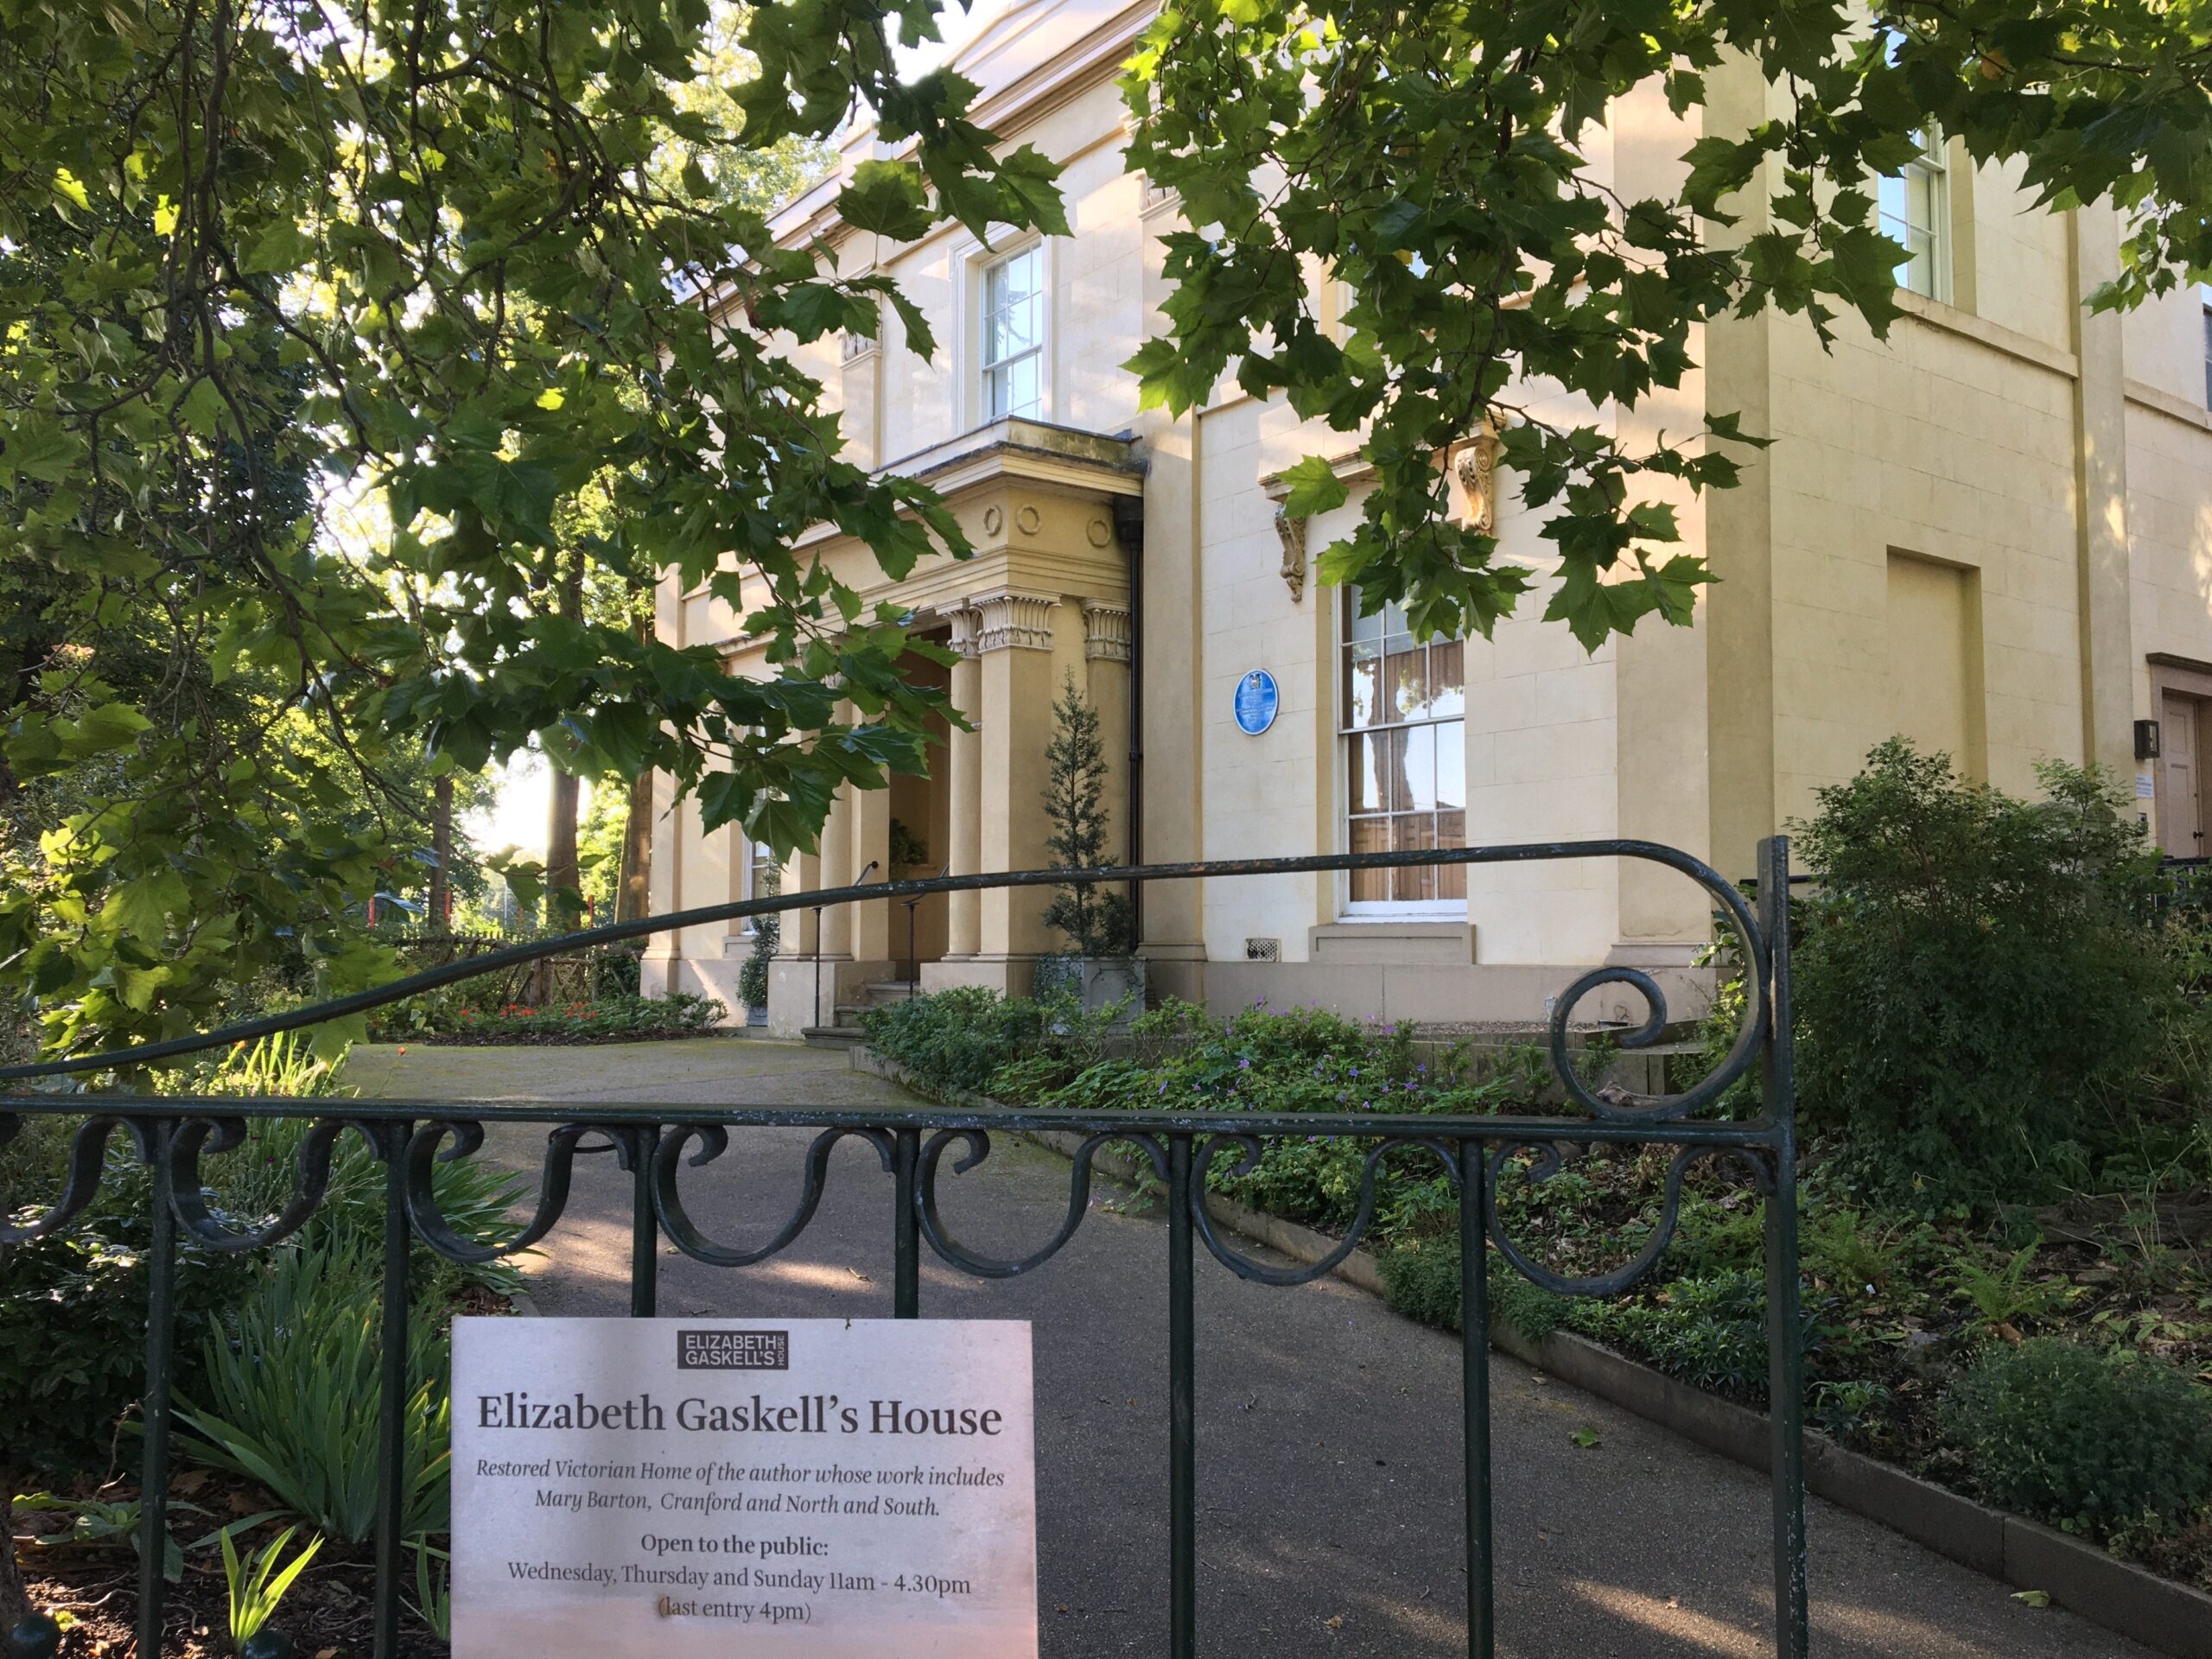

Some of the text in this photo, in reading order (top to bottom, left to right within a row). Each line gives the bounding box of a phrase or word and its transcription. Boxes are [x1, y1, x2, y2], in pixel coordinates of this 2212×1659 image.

[685, 1335, 776, 1350] ELIZABETH
[685, 1351, 775, 1366] GASKELL'S
[478, 1392, 1002, 1435] Elizabeth Gaskell's House
[477, 1459, 1004, 1486] Restored Victorian Home of the author whose work includes
[536, 1490, 939, 1516] Mary Barton, Cranford and North and South.
[641, 1535, 828, 1560] Open to the public:
[508, 1561, 617, 1586] Wednesday,
[621, 1564, 709, 1590] Thursday
[714, 1567, 748, 1586] and
[754, 1569, 824, 1594] Sunday
[894, 1574, 971, 1599] 4.30pm
[702, 1602, 754, 1624] entry
[760, 1602, 810, 1624] 4pm)
